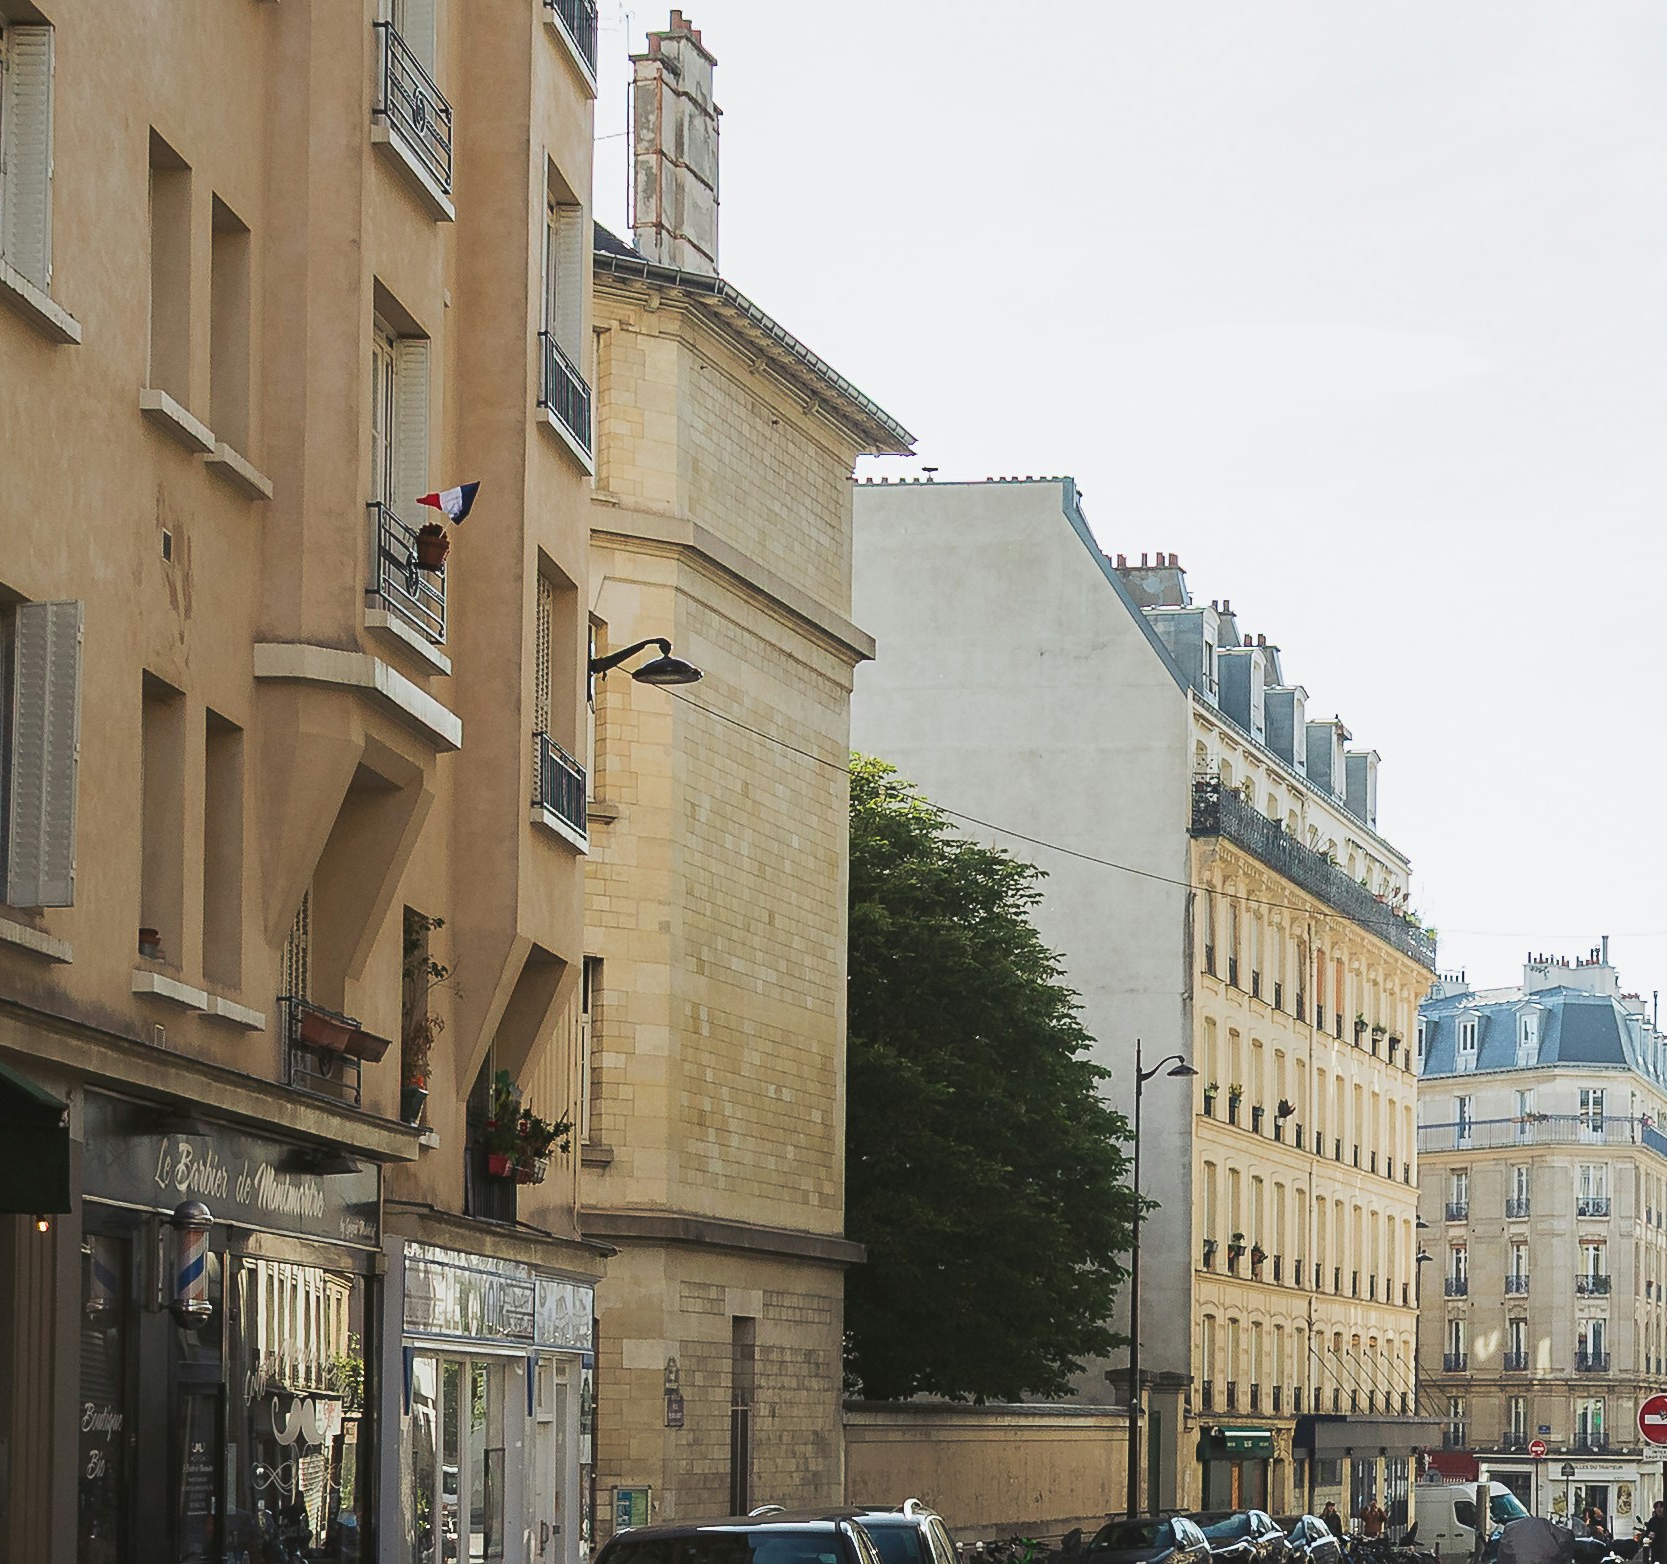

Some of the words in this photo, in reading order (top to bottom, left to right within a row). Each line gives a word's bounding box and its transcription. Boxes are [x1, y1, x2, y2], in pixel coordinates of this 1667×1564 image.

[155, 1137, 174, 1190] Le
[173, 1142, 230, 1201] Barbier
[236, 1159, 253, 1206] de
[254, 1161, 326, 1220] Montmartre
[85, 1449, 105, 1480] Bio
